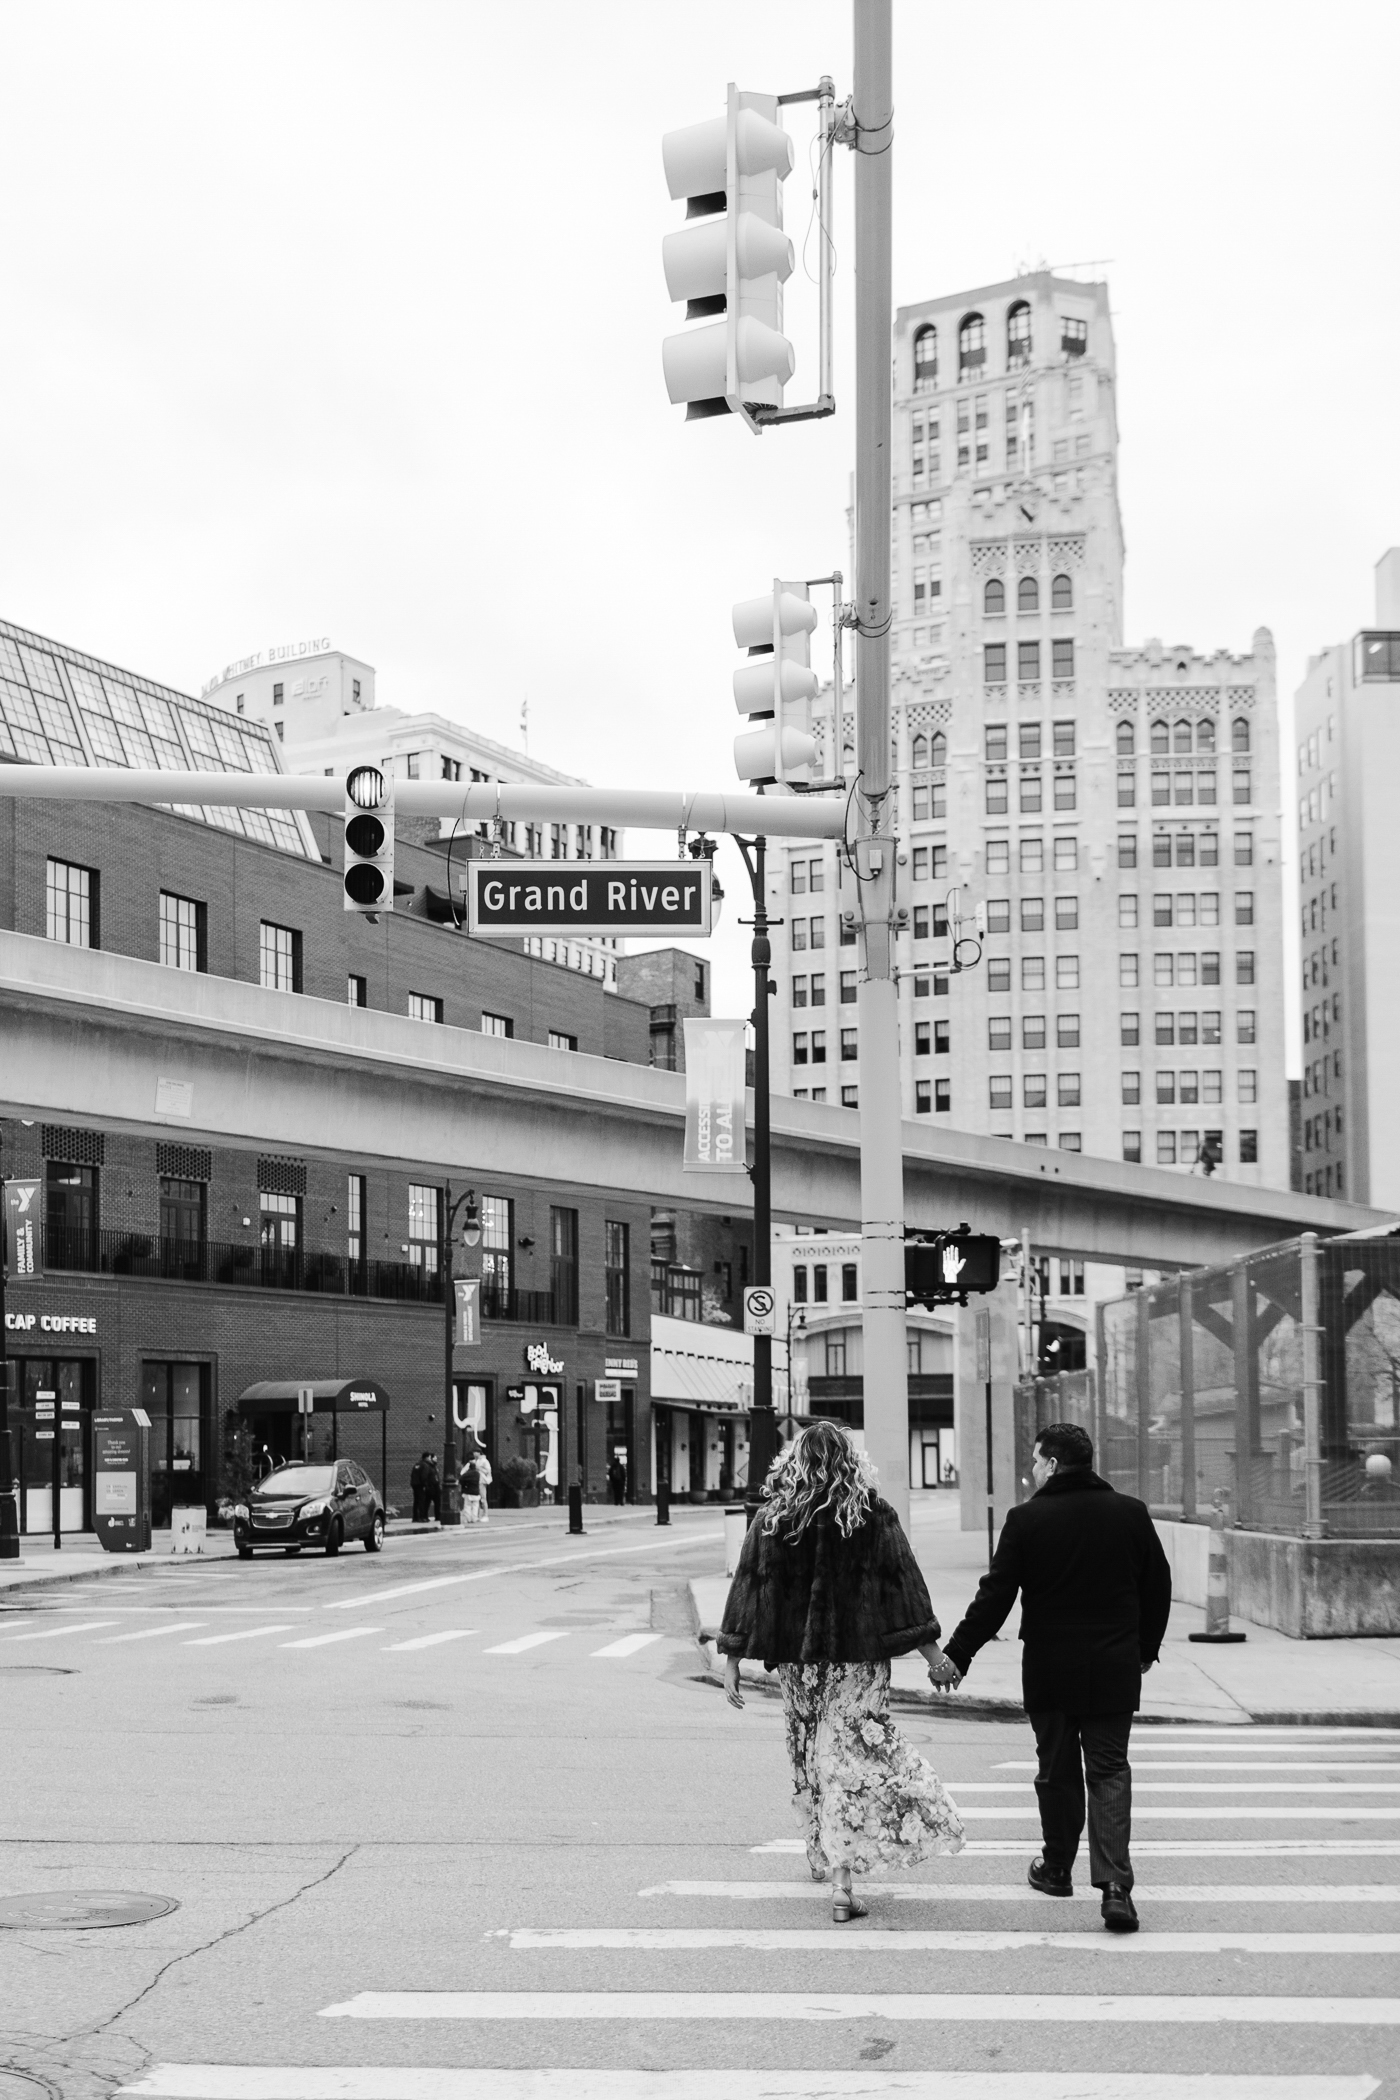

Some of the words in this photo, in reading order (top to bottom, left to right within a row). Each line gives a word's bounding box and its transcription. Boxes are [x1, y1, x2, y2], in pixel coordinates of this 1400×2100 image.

[269, 637, 331, 661] BUILDING
[483, 879, 588, 911] Grand
[608, 878, 696, 911] River
[715, 1133, 733, 1162] TO
[16, 1237, 26, 1274] FAMILY
[25, 1219, 34, 1273] COMMUNITY
[41, 1315, 97, 1334] COFFEE
[527, 1341, 548, 1361] good
[530, 1357, 565, 1375] neighbor
[350, 1391, 377, 1402] SHINOLA
